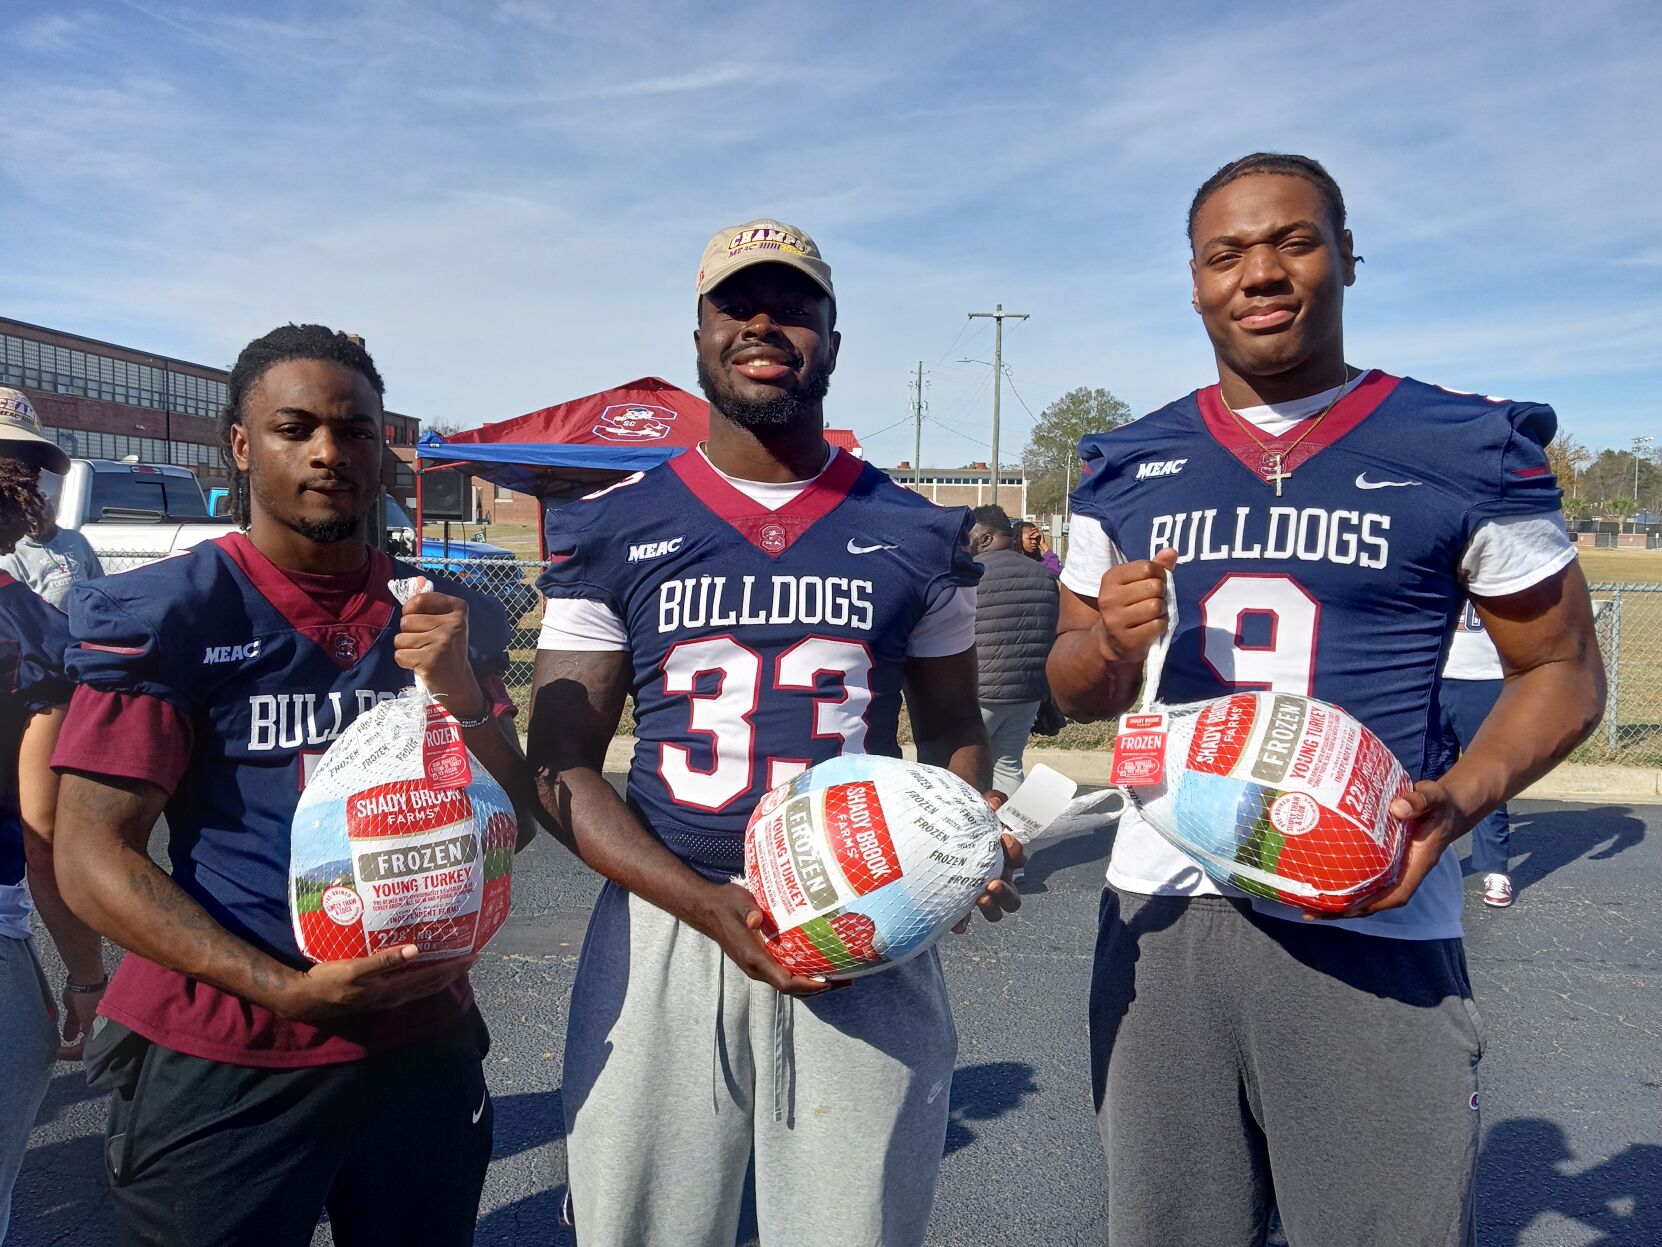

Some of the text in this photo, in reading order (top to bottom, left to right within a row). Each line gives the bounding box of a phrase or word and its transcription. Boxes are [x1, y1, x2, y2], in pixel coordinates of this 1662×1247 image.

[728, 228, 806, 253] CHAMPS
[1136, 458, 1187, 480] MEAC
[627, 537, 683, 562] MEAC
[1150, 506, 1391, 570] BULLDOGS
[658, 574, 874, 633] BULLDOGS
[1200, 571, 1322, 699] 9
[202, 640, 260, 665] MEAC
[426, 725, 460, 747] ROZEN
[657, 633, 877, 813] 33
[1223, 706, 1243, 742] FARMS
[1262, 703, 1302, 766] FROZEN
[362, 743, 390, 770] FROZEN
[395, 736, 418, 762] FROZEN
[1120, 734, 1163, 750] FROZEN
[1196, 725, 1225, 765] SHADY
[1289, 739, 1319, 779] YOUNG
[1305, 705, 1326, 738] TURKEY
[329, 749, 360, 778] FROZEN
[1334, 743, 1352, 784] INDEPENDENT
[906, 769, 935, 791] FROZEN
[356, 792, 408, 818] SHADY
[905, 790, 940, 815] FROZEN
[387, 810, 435, 826] FARMS
[913, 817, 950, 843] FROZEN
[772, 813, 788, 859] YOUNG
[837, 813, 858, 858] FARMS
[846, 786, 892, 880] SHADY BROOK
[377, 842, 464, 876] FROZEN
[789, 811, 827, 893] FROZEN
[929, 849, 968, 867] FROZEN
[372, 866, 472, 898] YOUNG TURKEY
[779, 858, 808, 907] TURKEY
[947, 874, 986, 888] FROZEN
[389, 905, 461, 924] INDEPENDENT FARMS
